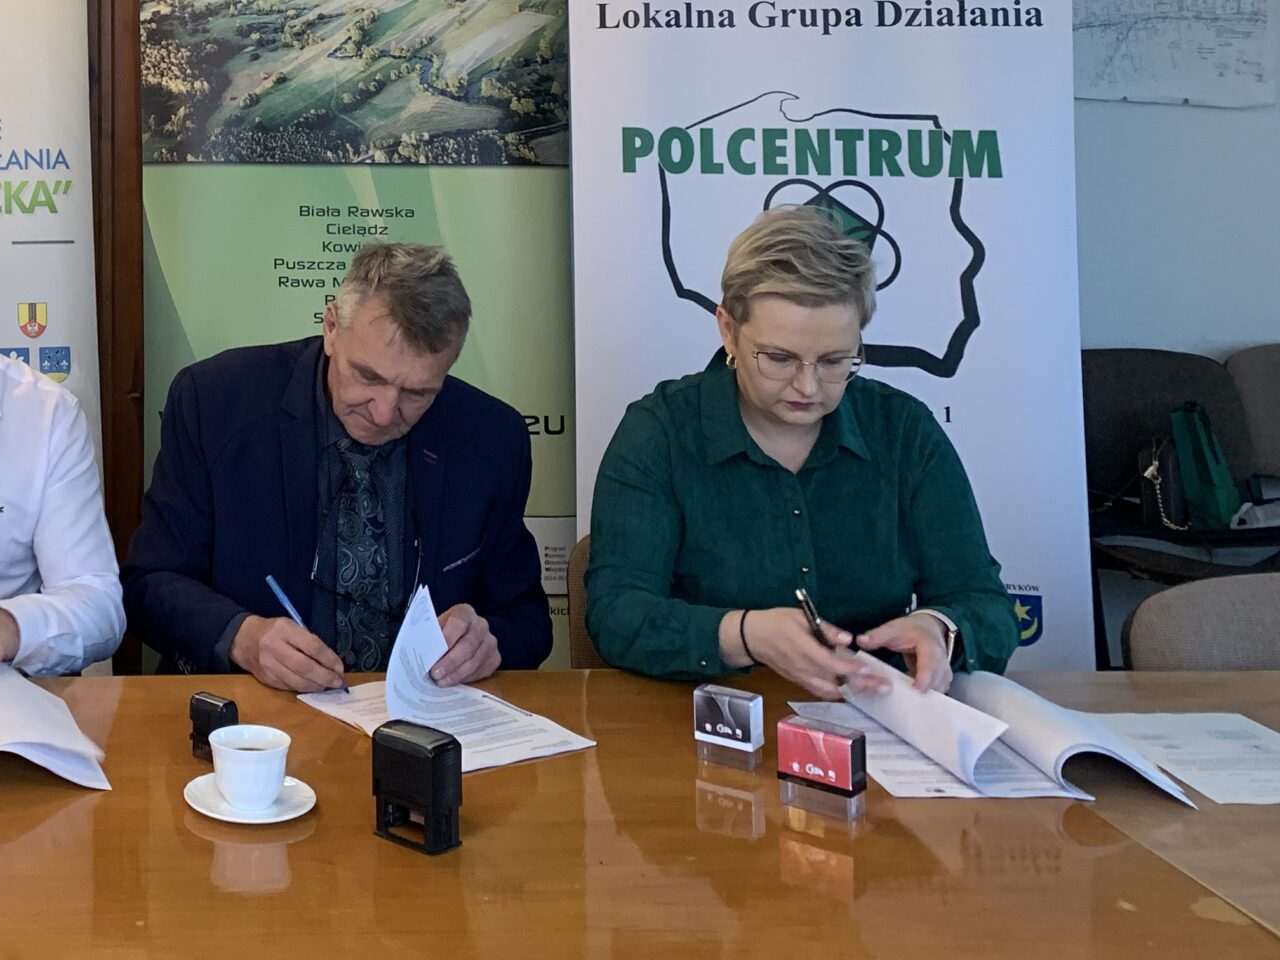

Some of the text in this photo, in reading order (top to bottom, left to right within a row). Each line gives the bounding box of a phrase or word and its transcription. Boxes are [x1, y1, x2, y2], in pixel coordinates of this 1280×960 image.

[596, 0, 1044, 35] Lokalna Grupa Działania
[621, 126, 1003, 179] POLCENTRUM
[299, 205, 415, 218] Biała Rawska
[326, 223, 389, 237] Cielądz
[322, 241, 367, 253] Kowi
[273, 258, 346, 271] Puszcza
[278, 276, 326, 288] Rawa
[943, 405, 952, 424] 1
[1006, 583, 1040, 592] RYKÓW
